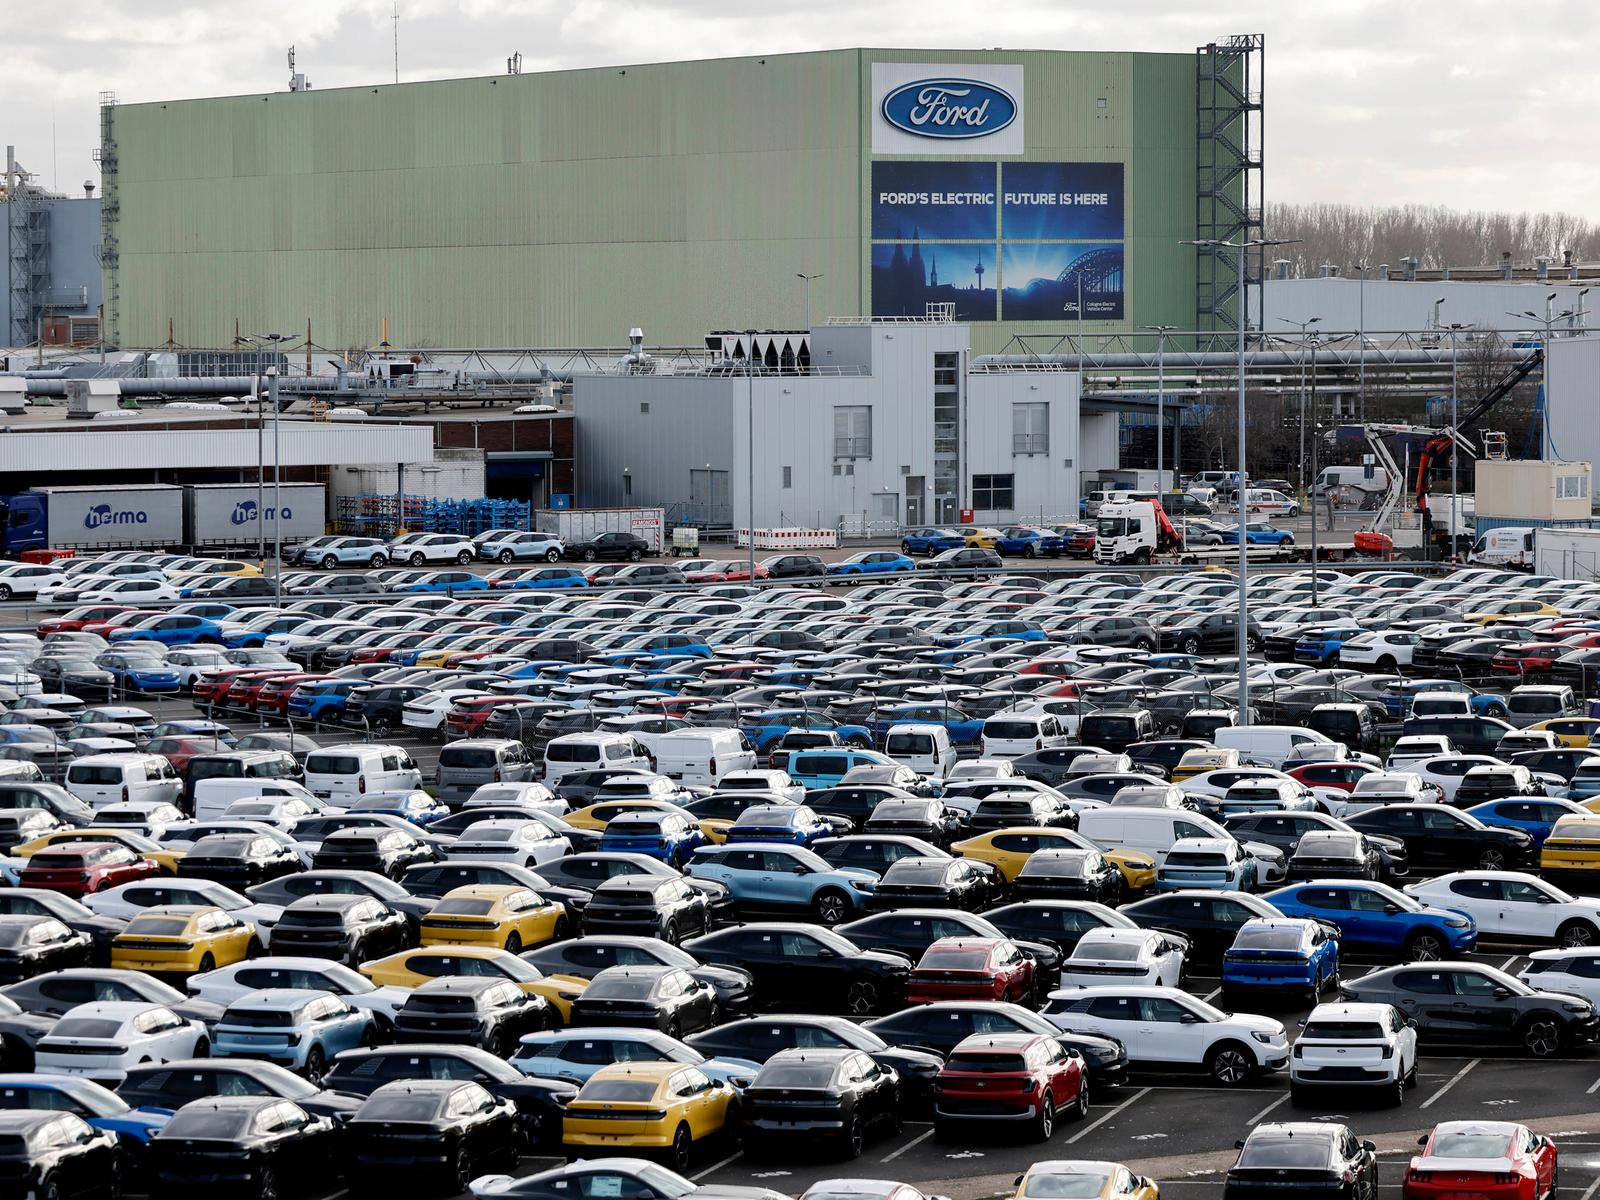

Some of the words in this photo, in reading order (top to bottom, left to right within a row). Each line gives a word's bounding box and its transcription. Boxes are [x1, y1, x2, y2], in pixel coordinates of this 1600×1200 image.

[910, 87, 990, 126] Ford
[931, 193, 994, 205] ELECTRIC
[1004, 193, 1056, 205] FUTURE
[1059, 193, 1072, 205] IS
[1074, 193, 1108, 205] HERE
[88, 506, 148, 525] herma
[235, 502, 293, 521] hema
